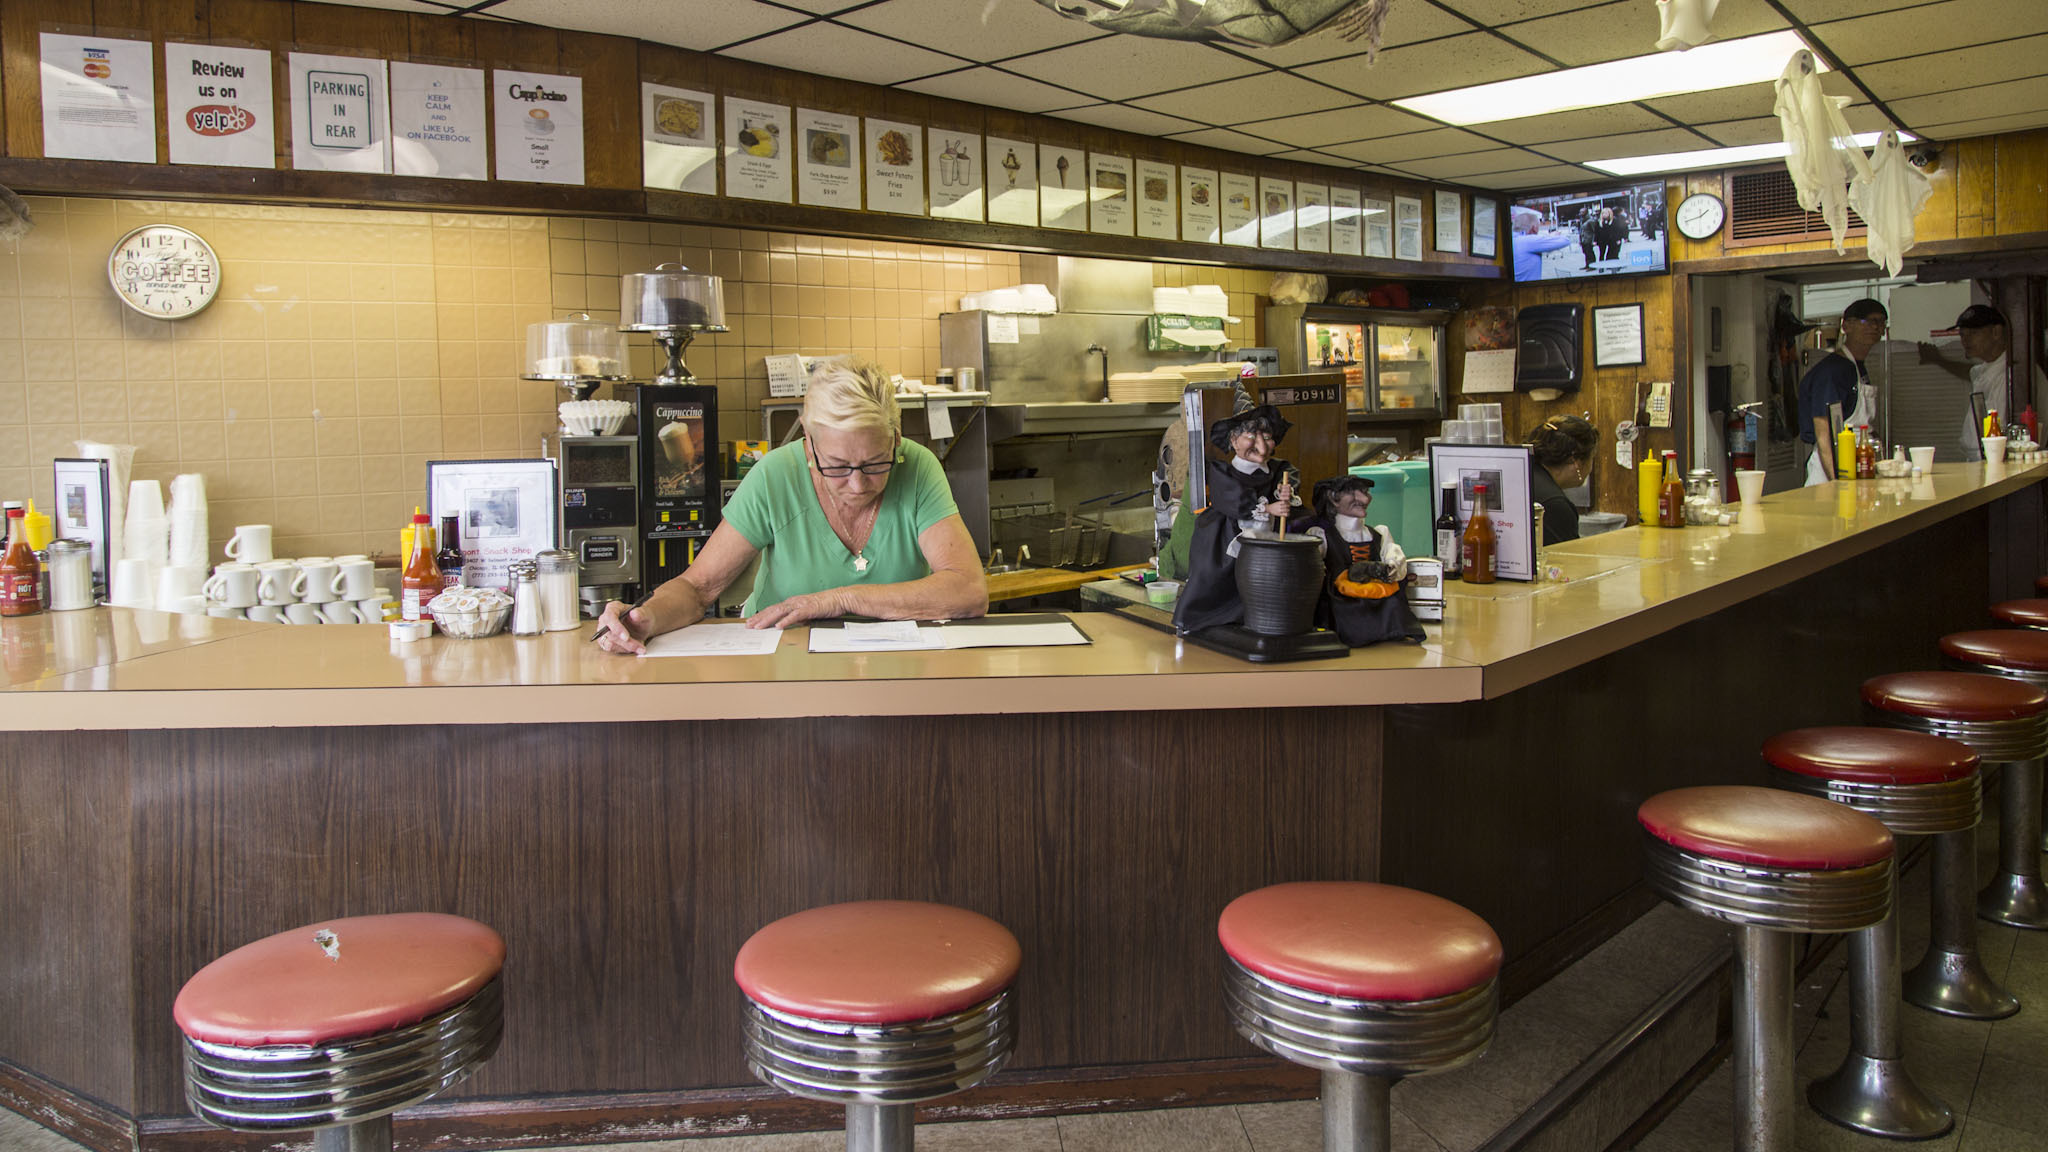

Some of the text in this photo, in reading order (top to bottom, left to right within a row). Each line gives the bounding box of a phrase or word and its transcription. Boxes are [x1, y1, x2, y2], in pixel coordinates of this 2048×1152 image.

[192, 60, 245, 78] Review
[199, 85, 237, 98] us on
[313, 81, 365, 97] PARKING
[427, 94, 449, 102] KEEP
[333, 103, 346, 116] IN
[425, 102, 451, 110] CALM
[194, 111, 229, 131] yelp
[326, 125, 356, 138] REAR
[423, 124, 455, 133] LIKE US
[423, 133, 471, 143] FACEBOOK
[531, 143, 549, 151] Small
[530, 157, 550, 166] Large
[876, 169, 894, 177] Sweet
[888, 181, 903, 189] Fries
[141, 237, 150, 248] 11
[159, 235, 173, 246] 12
[127, 249, 140, 260] 10
[121, 261, 211, 283] COFFEE
[128, 282, 138, 294] 8
[144, 294, 151, 305] 7
[162, 300, 173, 311] 6
[1294, 389, 1325, 401] 2091
[656, 406, 703, 420] Cappuccino
[1497, 520, 1514, 528] Shop
[512, 546, 533, 555] Shop
[17, 584, 32, 593] HOT
